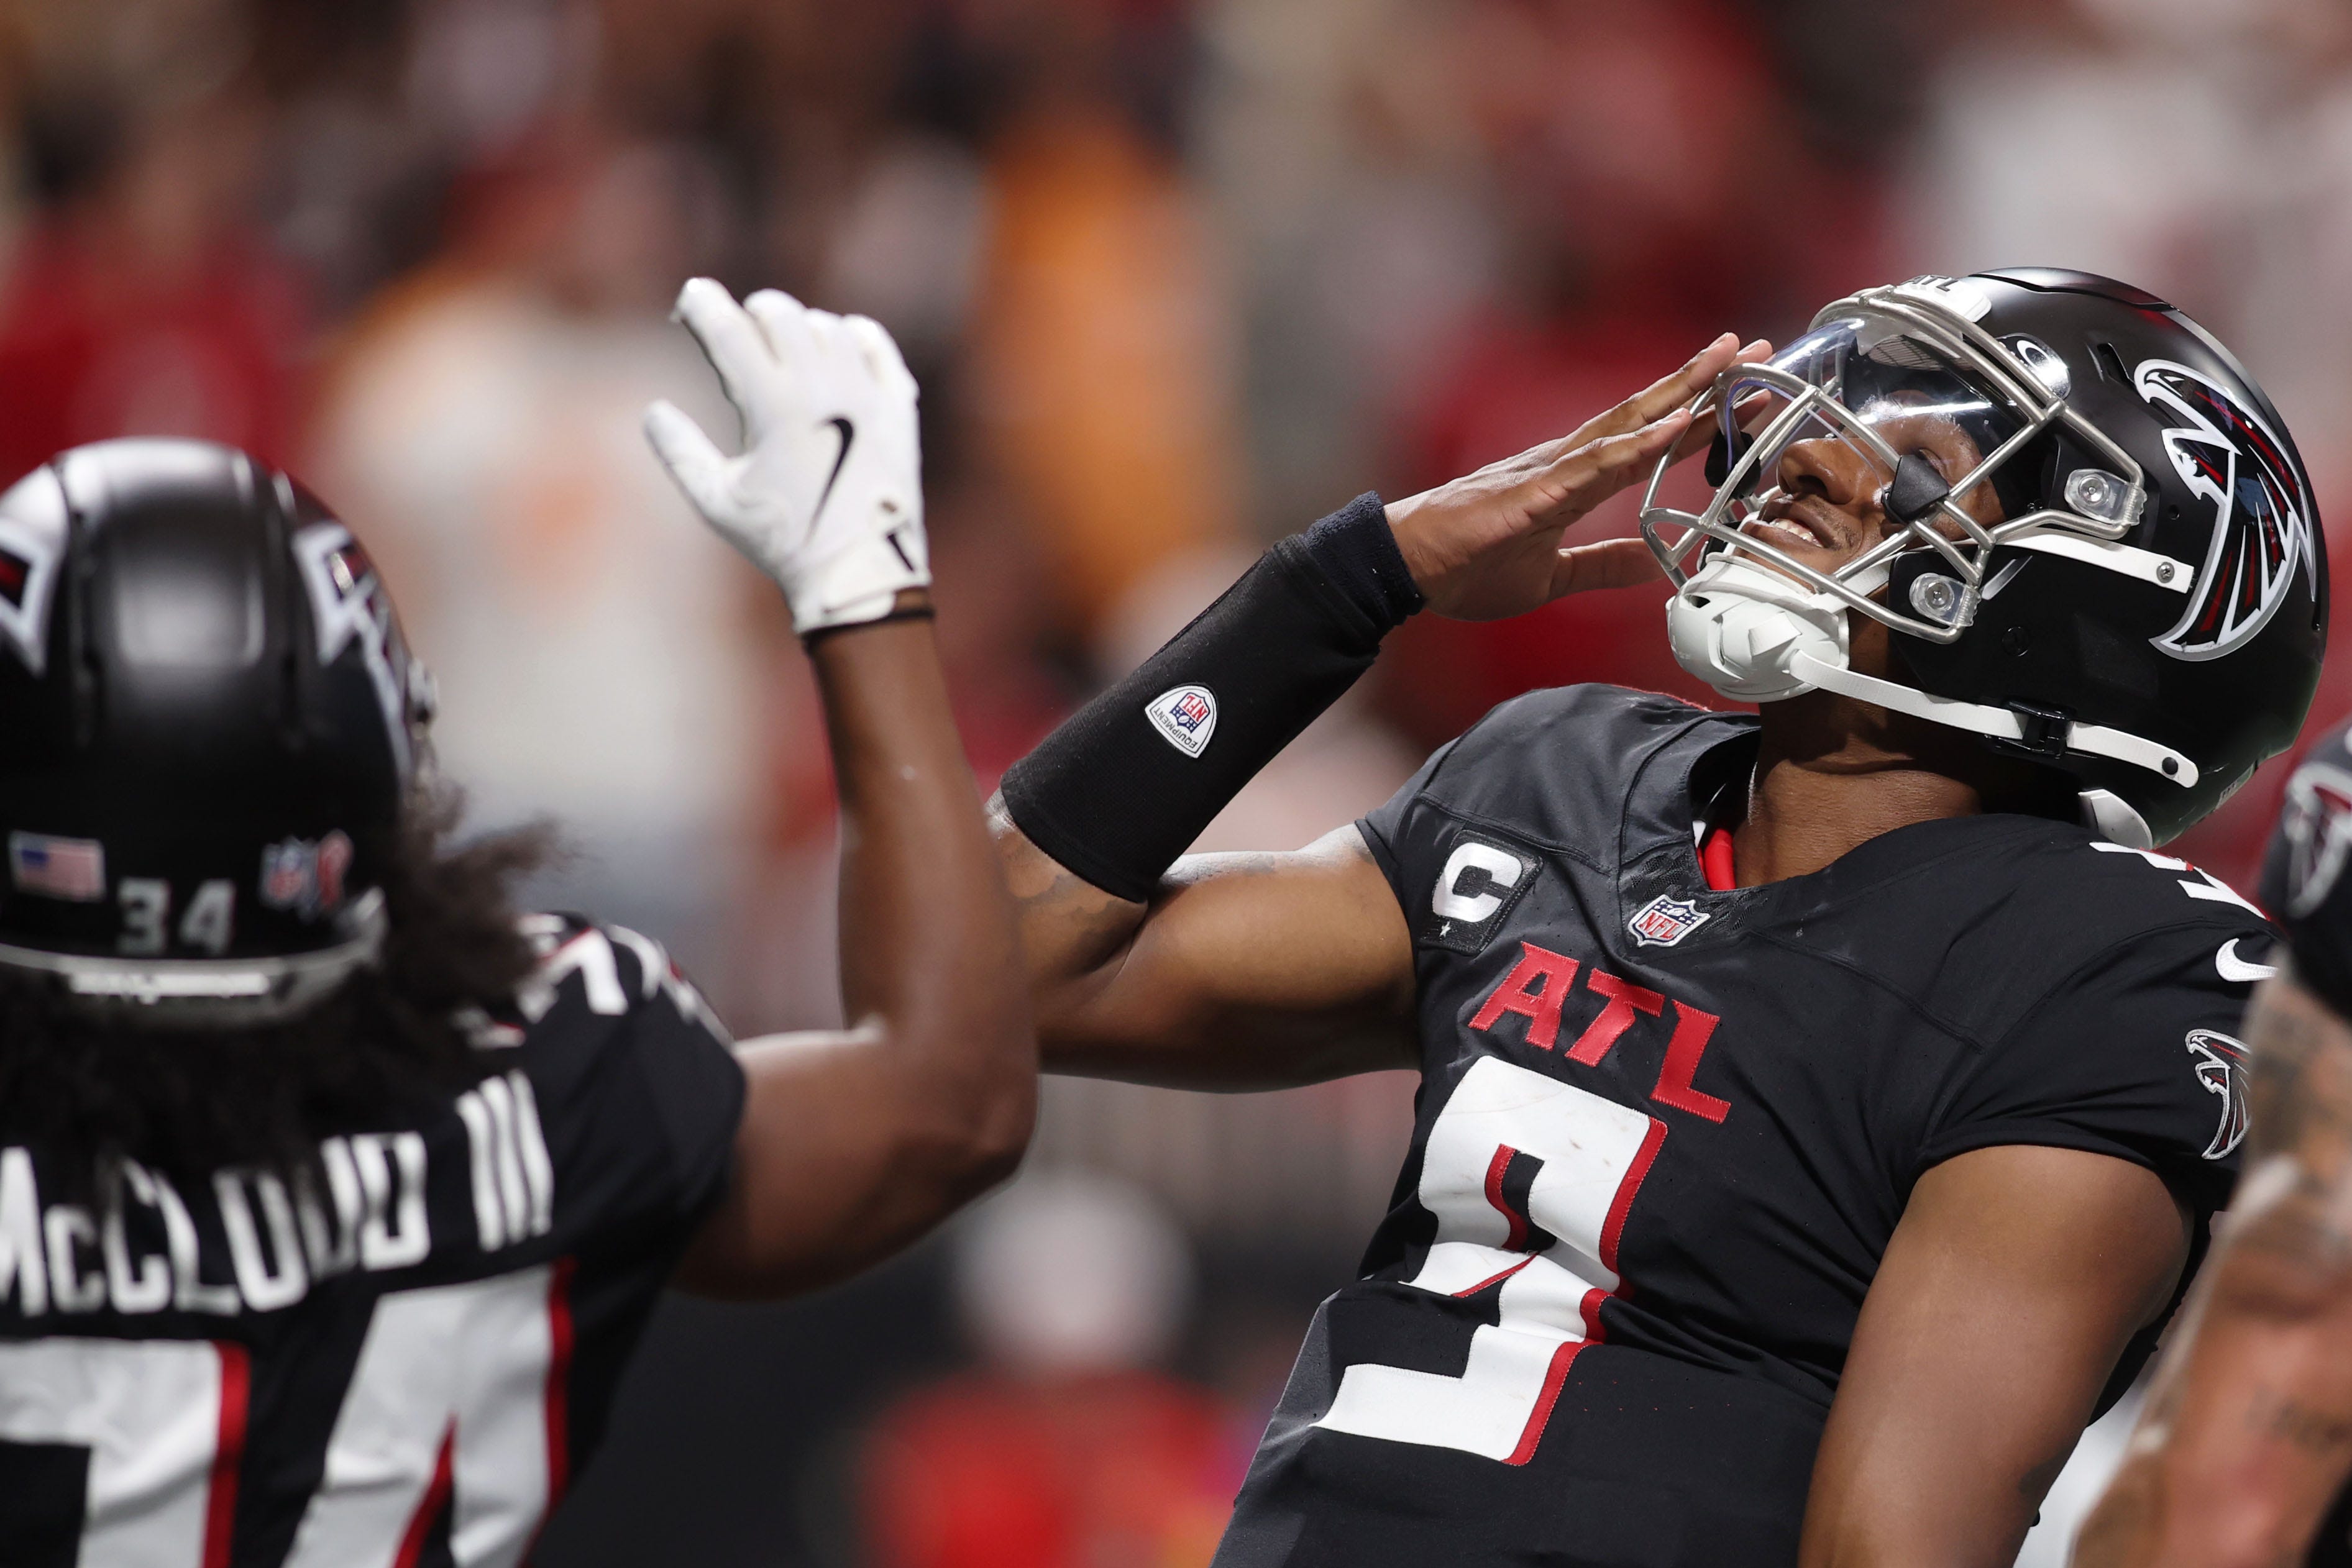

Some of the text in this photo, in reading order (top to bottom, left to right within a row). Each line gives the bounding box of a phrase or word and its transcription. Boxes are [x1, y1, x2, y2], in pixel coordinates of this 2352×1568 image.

[1153, 707, 1198, 749] EQUIPMENT
[1182, 695, 1208, 722] NFL
[117, 877, 237, 956] 34
[1432, 842, 1522, 923] C
[1638, 911, 1680, 939] NFL
[1468, 941, 1731, 1124] ATL
[455, 1069, 554, 1252] III
